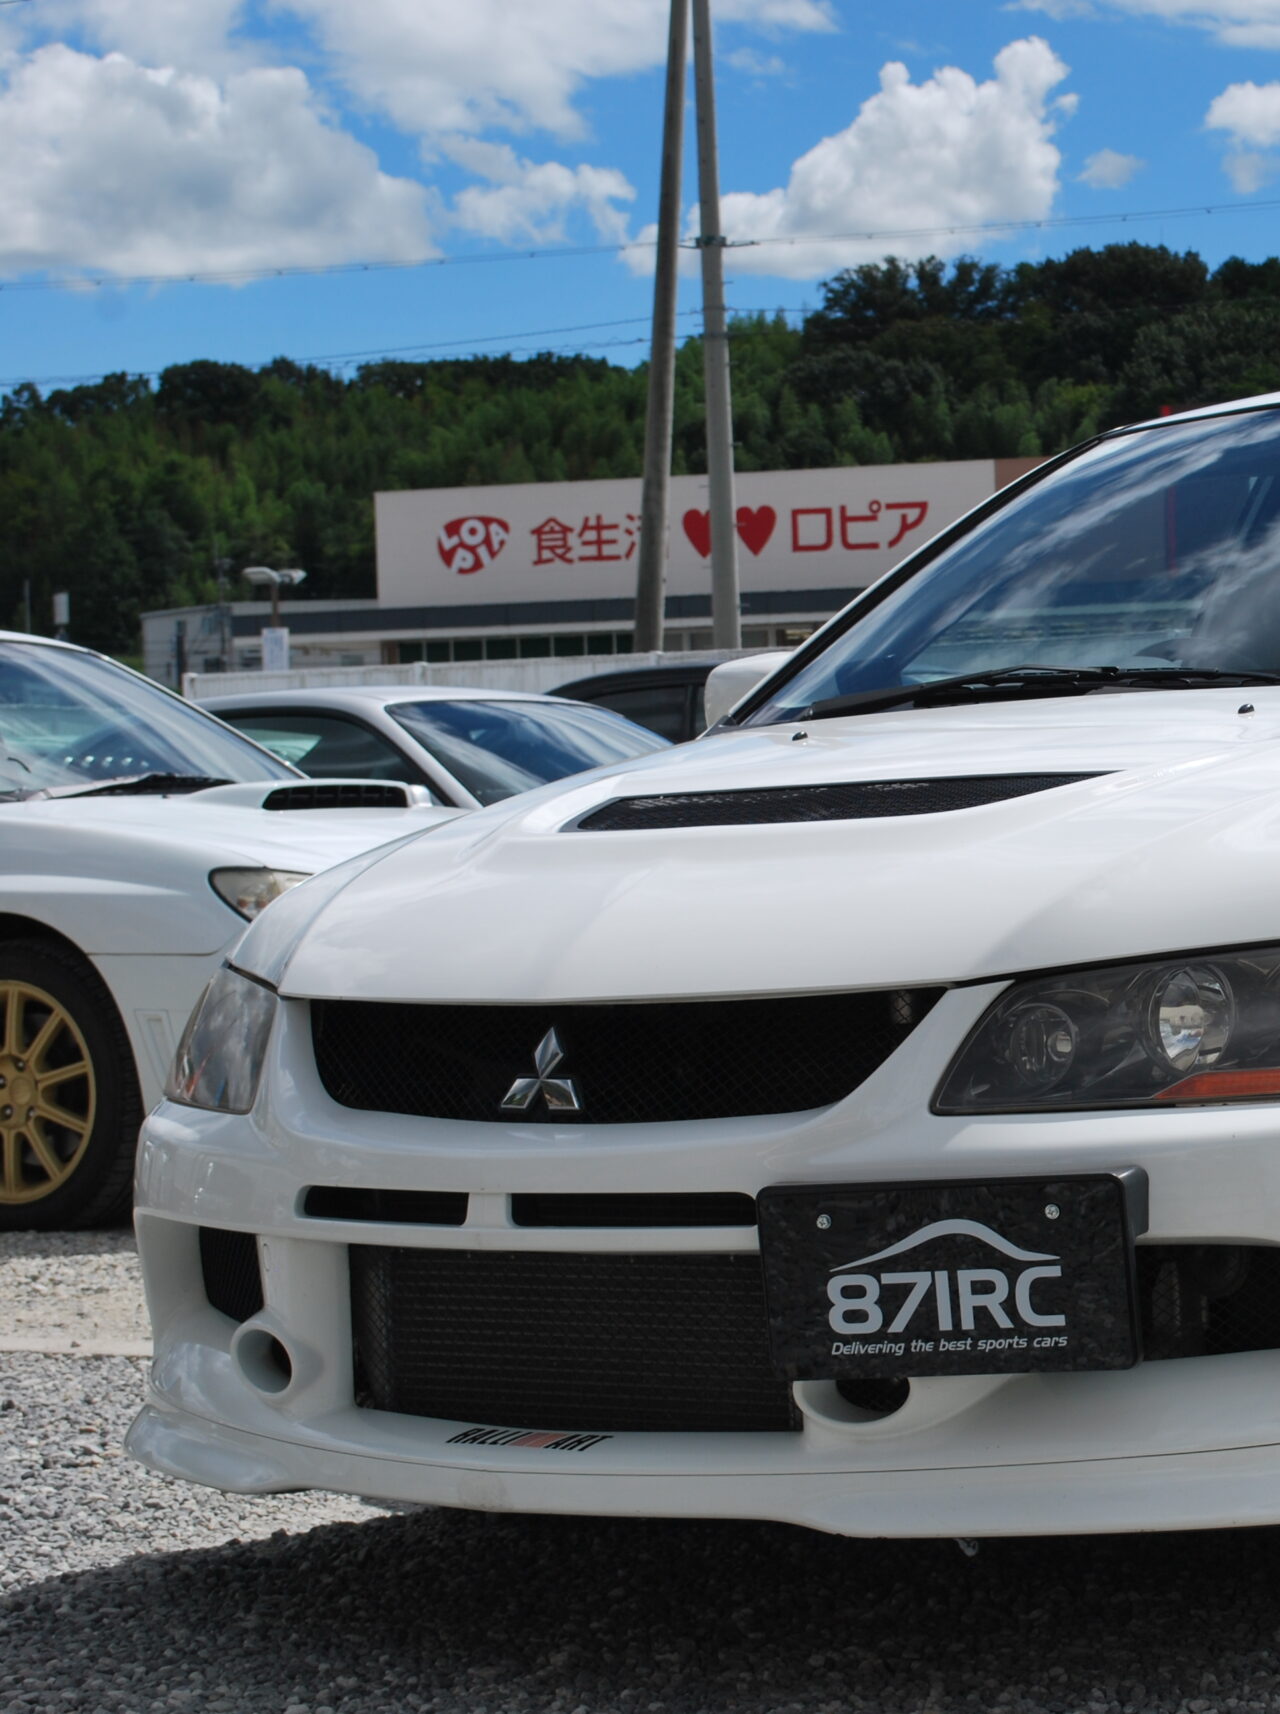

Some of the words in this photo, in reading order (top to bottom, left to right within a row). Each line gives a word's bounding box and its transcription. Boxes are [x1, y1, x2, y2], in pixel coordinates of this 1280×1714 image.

[791, 500, 930, 553] ロピア
[831, 1341, 905, 1356] Delivering
[910, 1339, 934, 1353] the
[938, 1337, 972, 1352] best
[976, 1335, 1028, 1351] sports
[1032, 1335, 1068, 1348] cars
